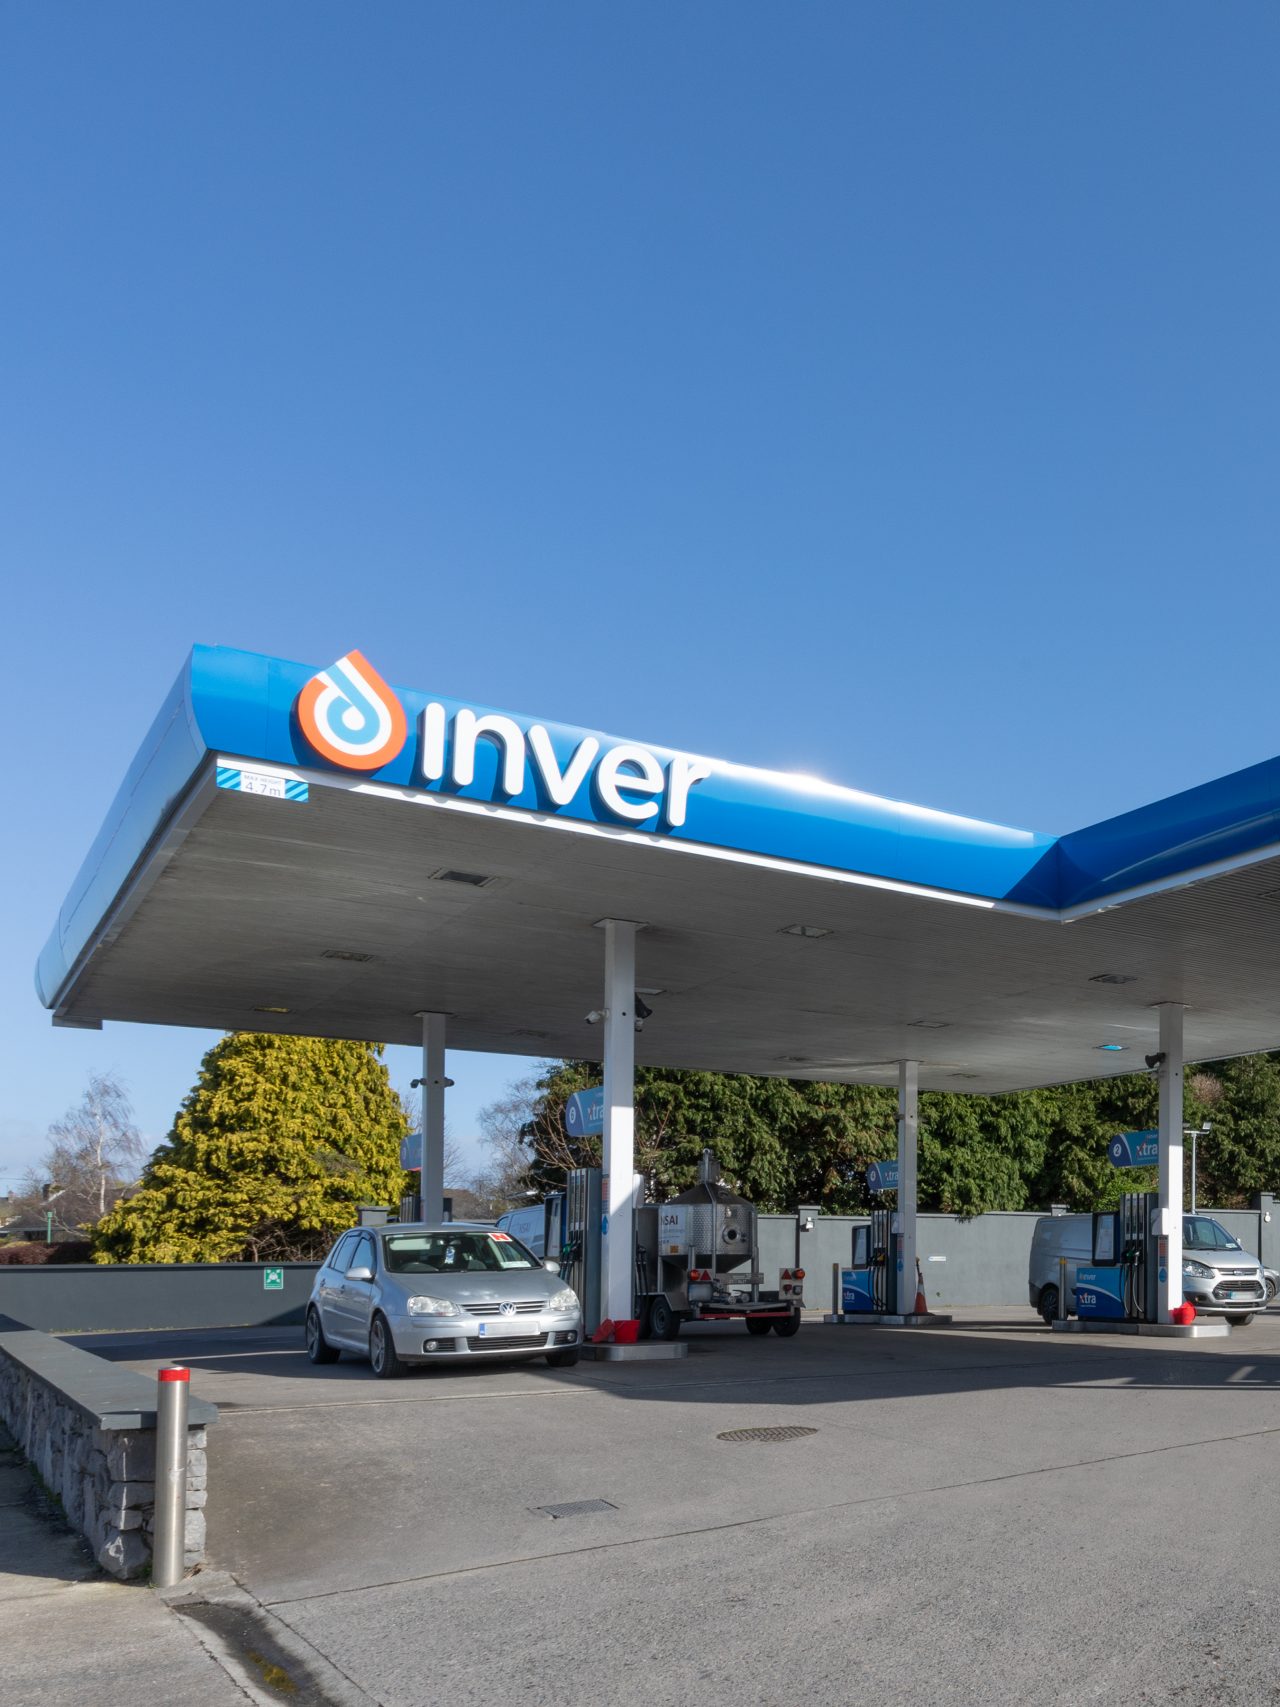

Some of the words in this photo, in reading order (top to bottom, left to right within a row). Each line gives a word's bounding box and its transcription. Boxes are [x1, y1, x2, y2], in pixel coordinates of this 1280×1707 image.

[421, 702, 712, 827] inver
[245, 782, 281, 796] 4.7m
[1136, 1142, 1158, 1157] xtra
